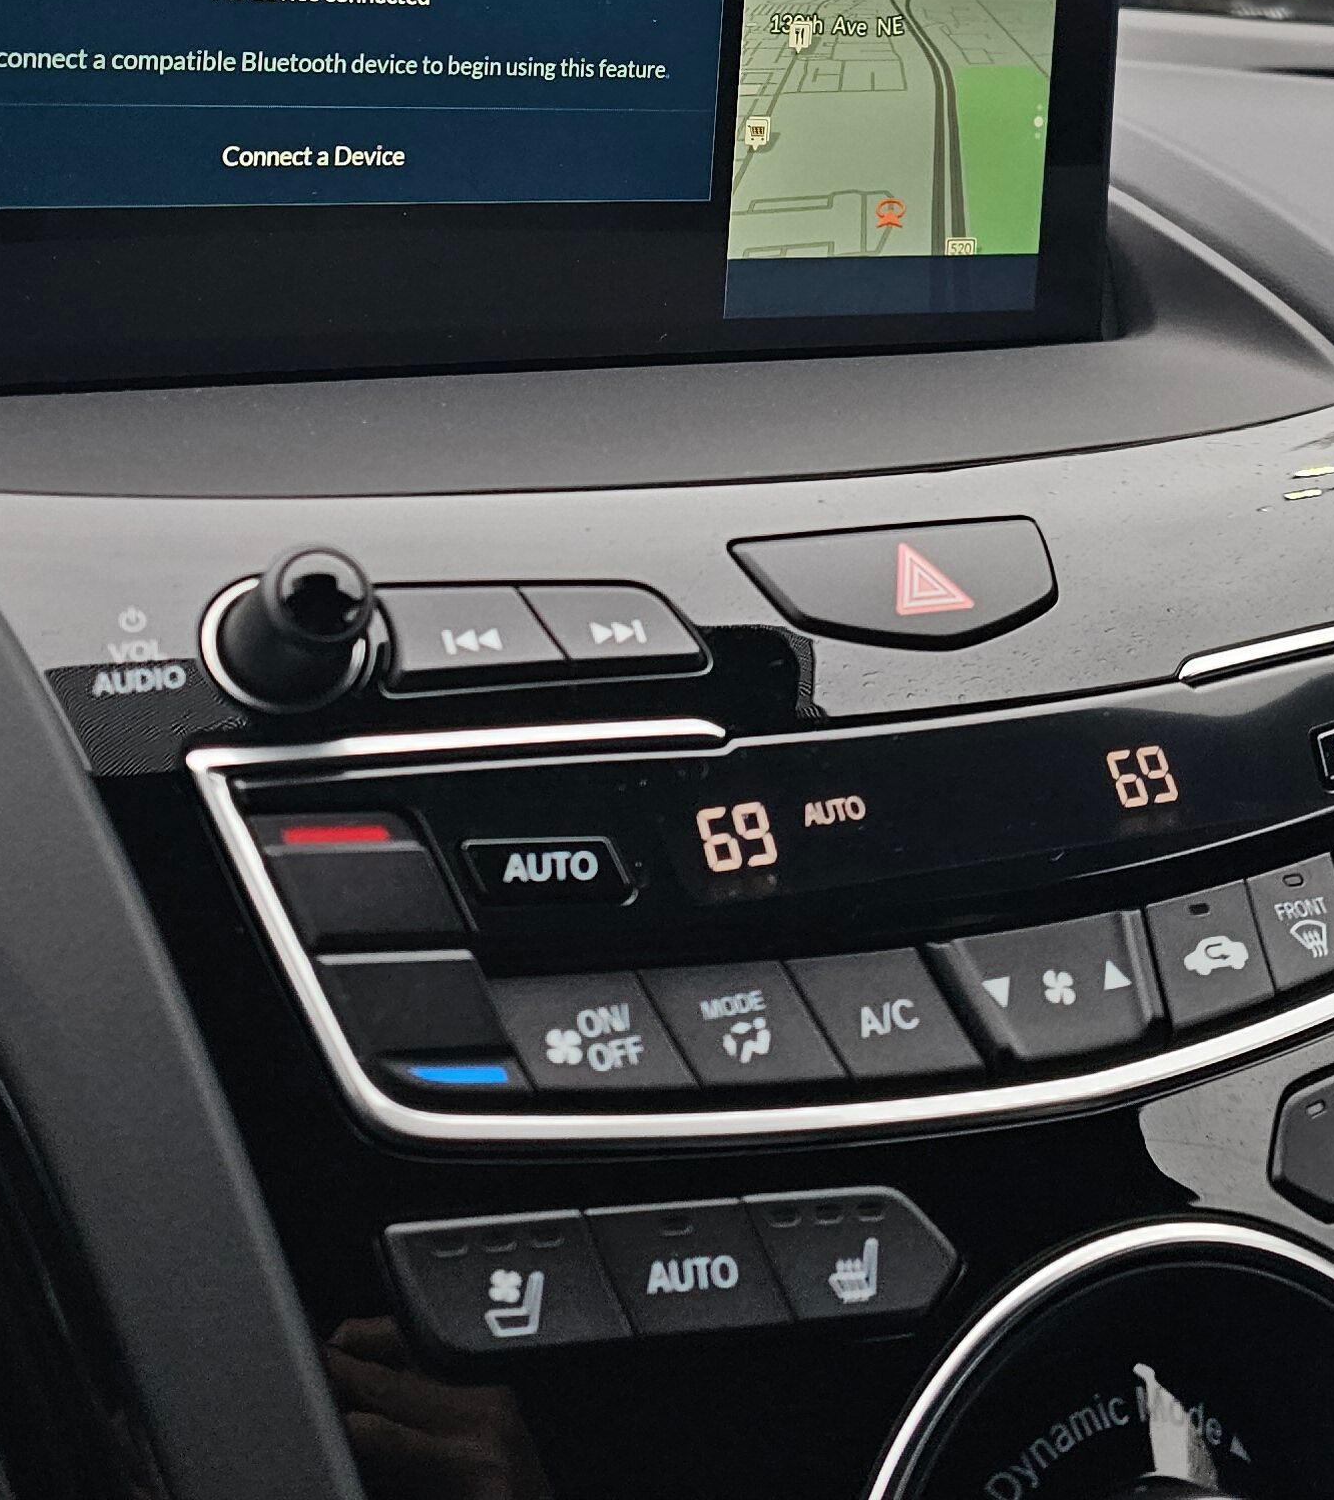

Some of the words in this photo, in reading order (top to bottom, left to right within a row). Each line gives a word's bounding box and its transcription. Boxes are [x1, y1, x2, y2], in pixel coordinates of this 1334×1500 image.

[770, 14, 823, 33] 13h
[833, 17, 867, 35] Ave
[878, 17, 904, 36] NE
[92, 53, 105, 70] a
[111, 50, 237, 76] compatible
[241, 51, 347, 74] Bluetooth
[351, 53, 418, 75] device
[422, 56, 443, 76] to
[447, 55, 501, 80] begin
[506, 56, 556, 81] using
[560, 57, 594, 78] this
[598, 58, 670, 79] feature.
[222, 145, 312, 167] Connect
[316, 150, 329, 166] a
[334, 144, 405, 166] Device
[951, 243, 972, 254] 520
[108, 638, 165, 663] VOL
[92, 664, 187, 697] AUDIO
[1106, 745, 1179, 808] 69
[804, 796, 866, 827] AUTO
[695, 800, 779, 873] 69
[502, 851, 599, 884] AUTO
[1274, 896, 1328, 920] FRONT
[699, 989, 767, 1020] MODE
[860, 998, 920, 1039] A/C
[587, 1035, 645, 1072] OFF
[647, 1255, 739, 1295] AUTO
[984, 1393, 1129, 1500] Dynamic
